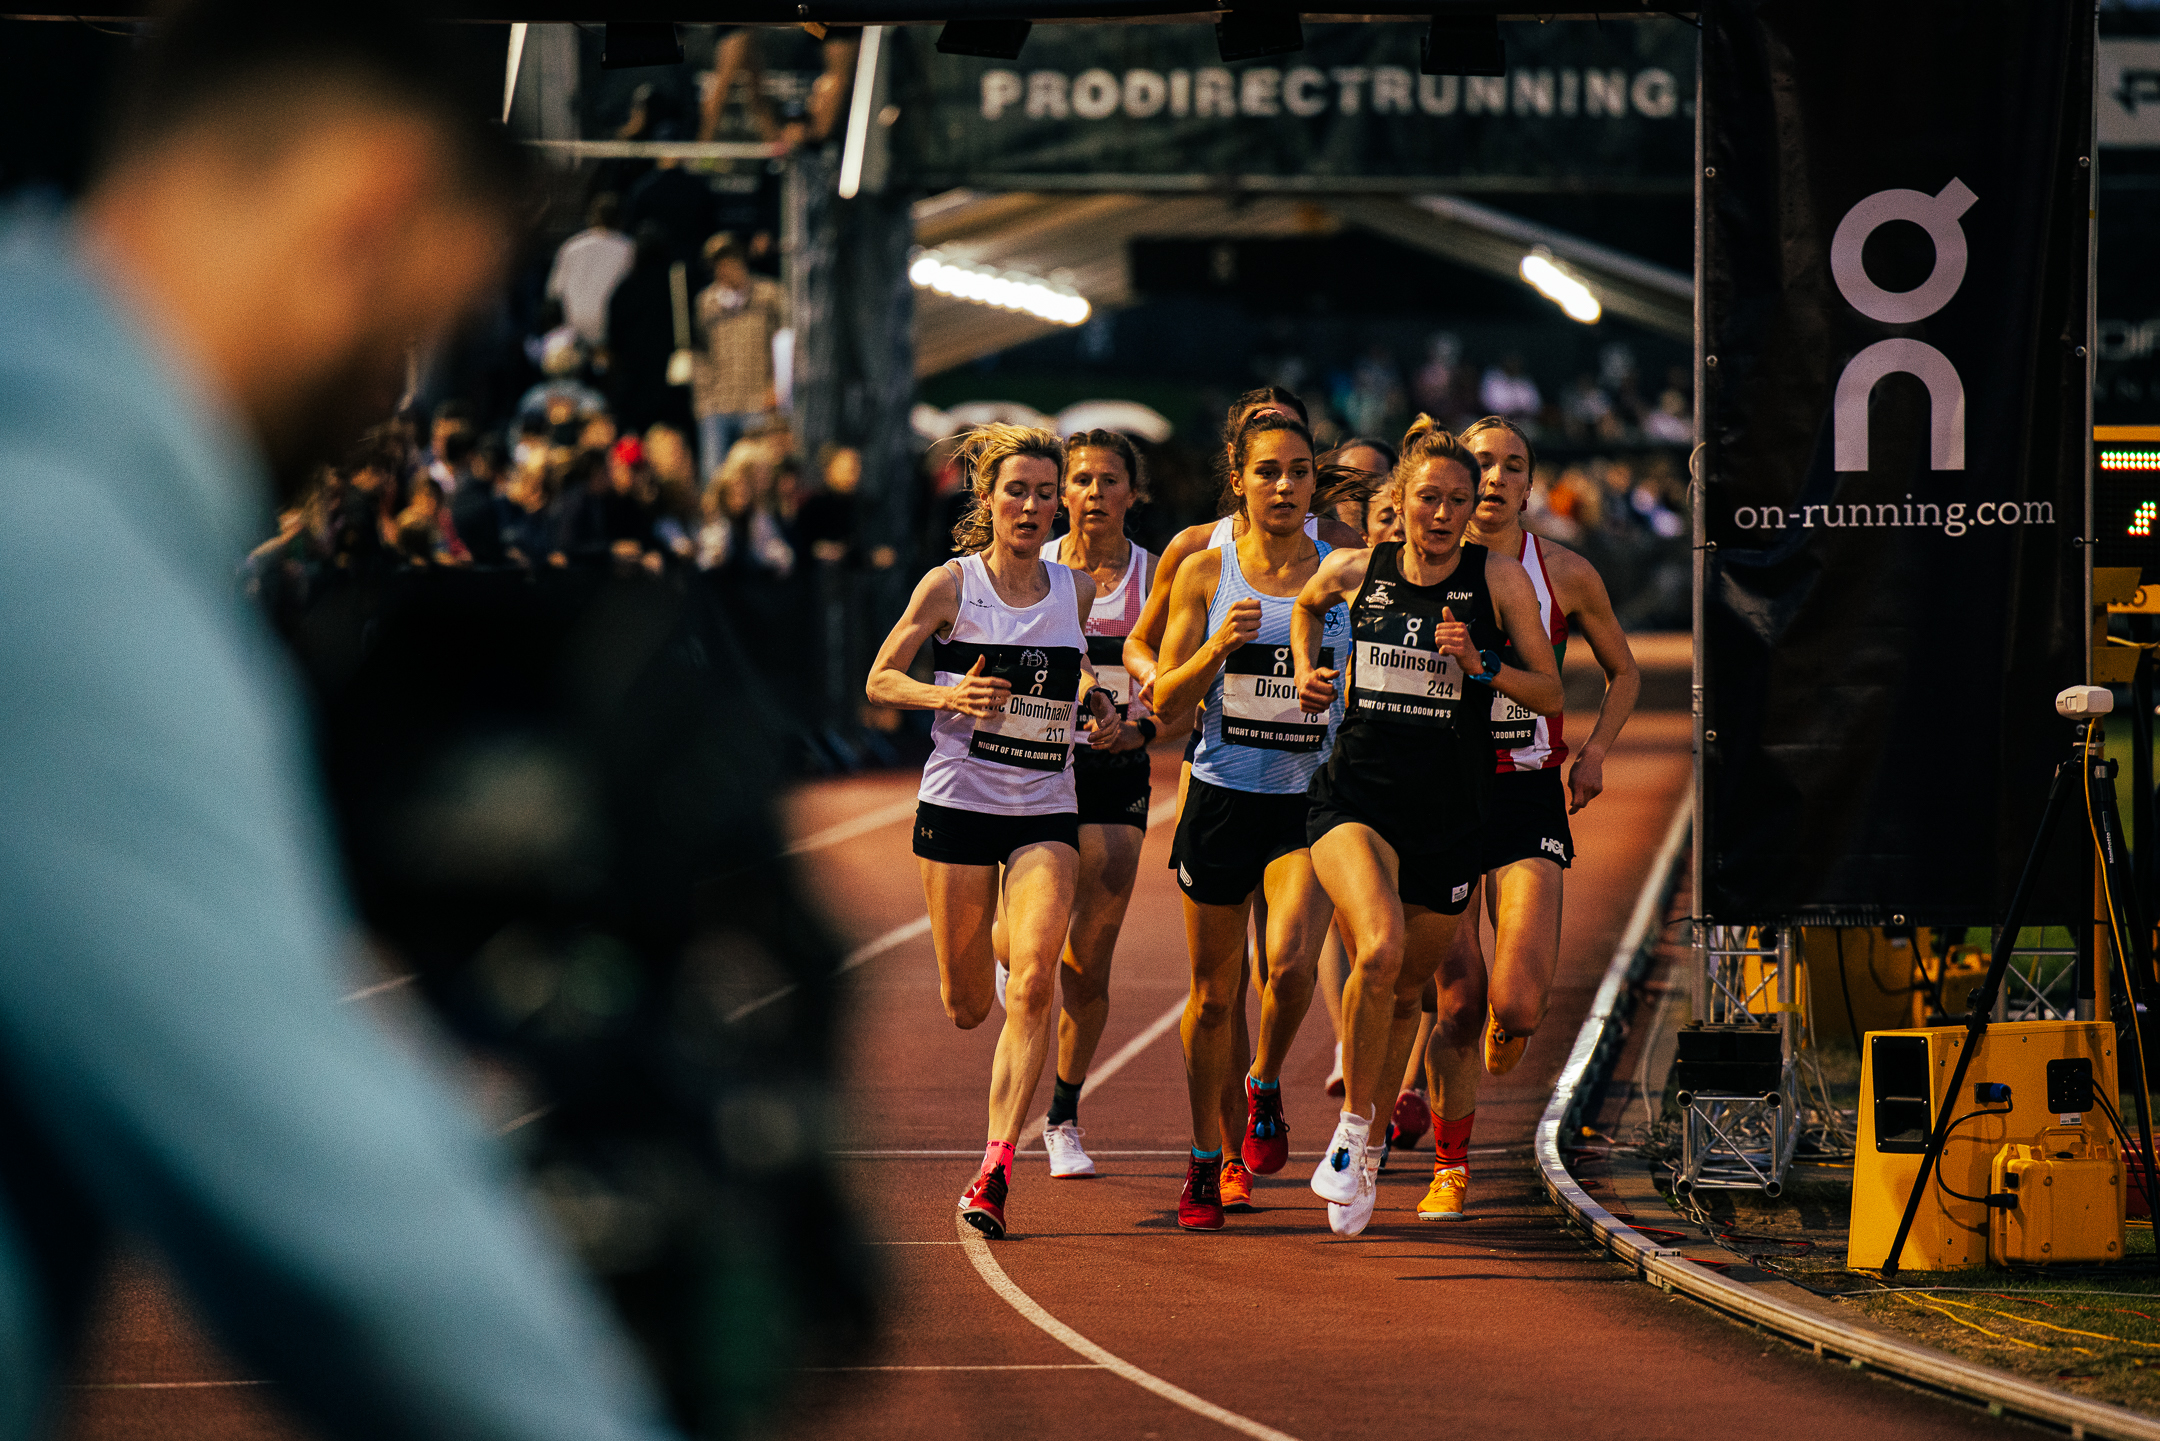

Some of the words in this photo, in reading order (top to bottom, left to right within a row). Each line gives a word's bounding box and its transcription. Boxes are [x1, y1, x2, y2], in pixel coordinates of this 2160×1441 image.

[1734, 493, 2055, 537] on-running.com
[1370, 646, 1447, 675] Robinson
[1427, 680, 1454, 698] 244
[1010, 697, 1072, 721] Dhomhnaill
[1358, 698, 1376, 709] NIGHT
[1376, 702, 1386, 711] OF
[1387, 703, 1401, 713] THE
[1402, 705, 1433, 716] 10,000M
[1435, 709, 1452, 719] PB'S
[1046, 727, 1065, 742] 217
[1227, 726, 1249, 737] NIGHT
[1250, 729, 1260, 738] OF
[1260, 731, 1274, 740] THE
[1275, 732, 1305, 743] 10,000M
[1516, 729, 1531, 738] PB'S
[977, 741, 1000, 752] NIGHT
[1000, 745, 1009, 754] OF
[1010, 747, 1023, 757] THE
